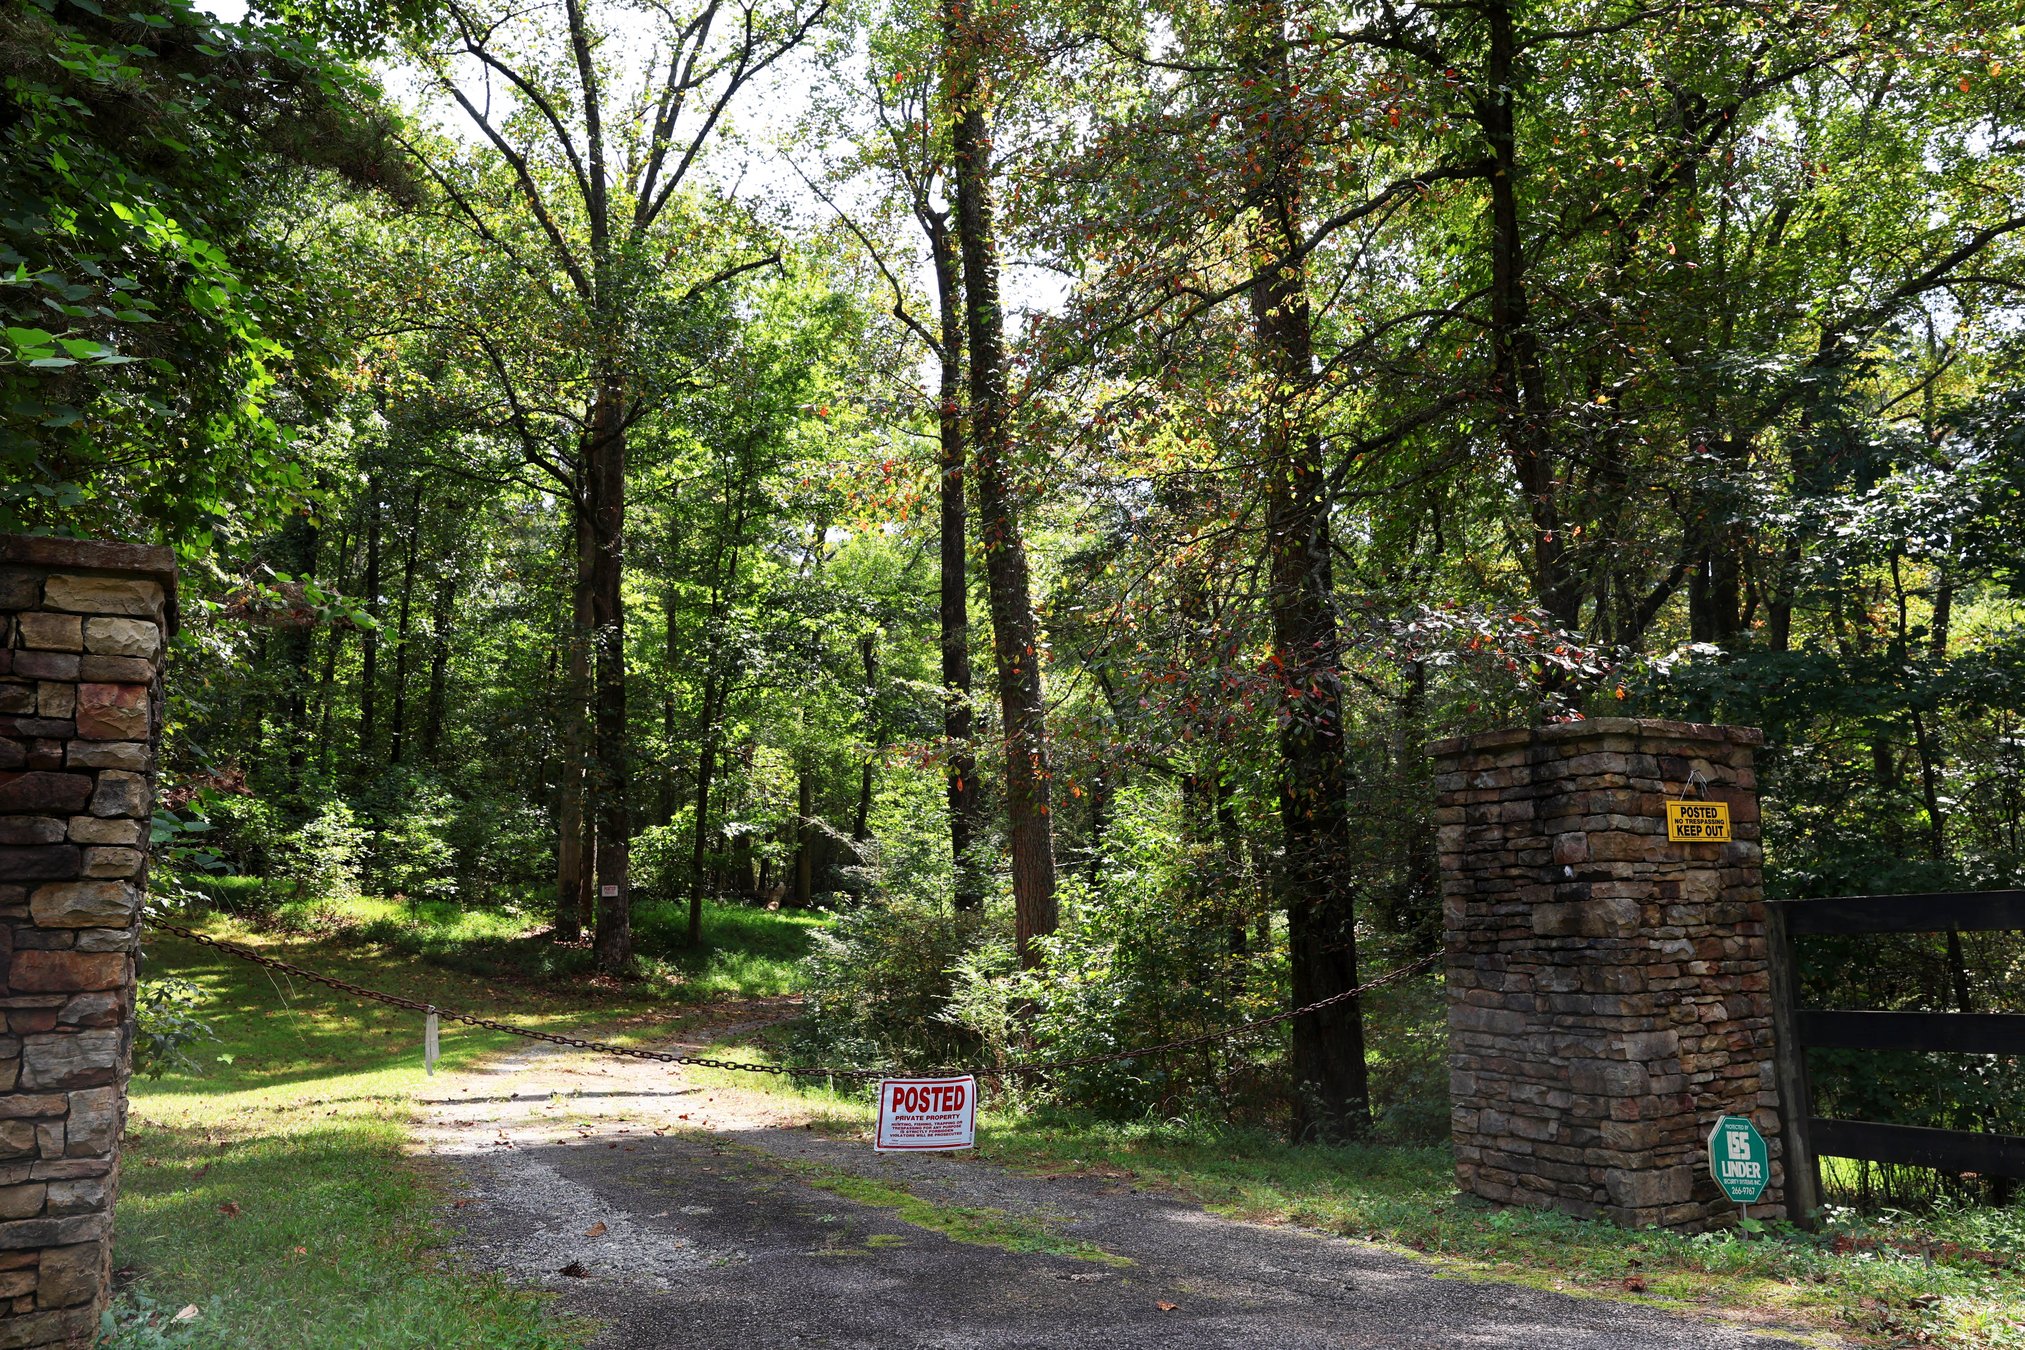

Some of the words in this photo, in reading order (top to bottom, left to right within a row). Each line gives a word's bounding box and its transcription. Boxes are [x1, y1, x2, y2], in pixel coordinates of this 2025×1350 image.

[1680, 806, 1718, 818] POSTED
[1677, 825, 1702, 836] KEEP
[1705, 826, 1724, 836] OUT
[892, 1085, 965, 1113] POSTED
[1721, 1161, 1762, 1179] LINDER
[1732, 1186, 1756, 1195] 266-9767
